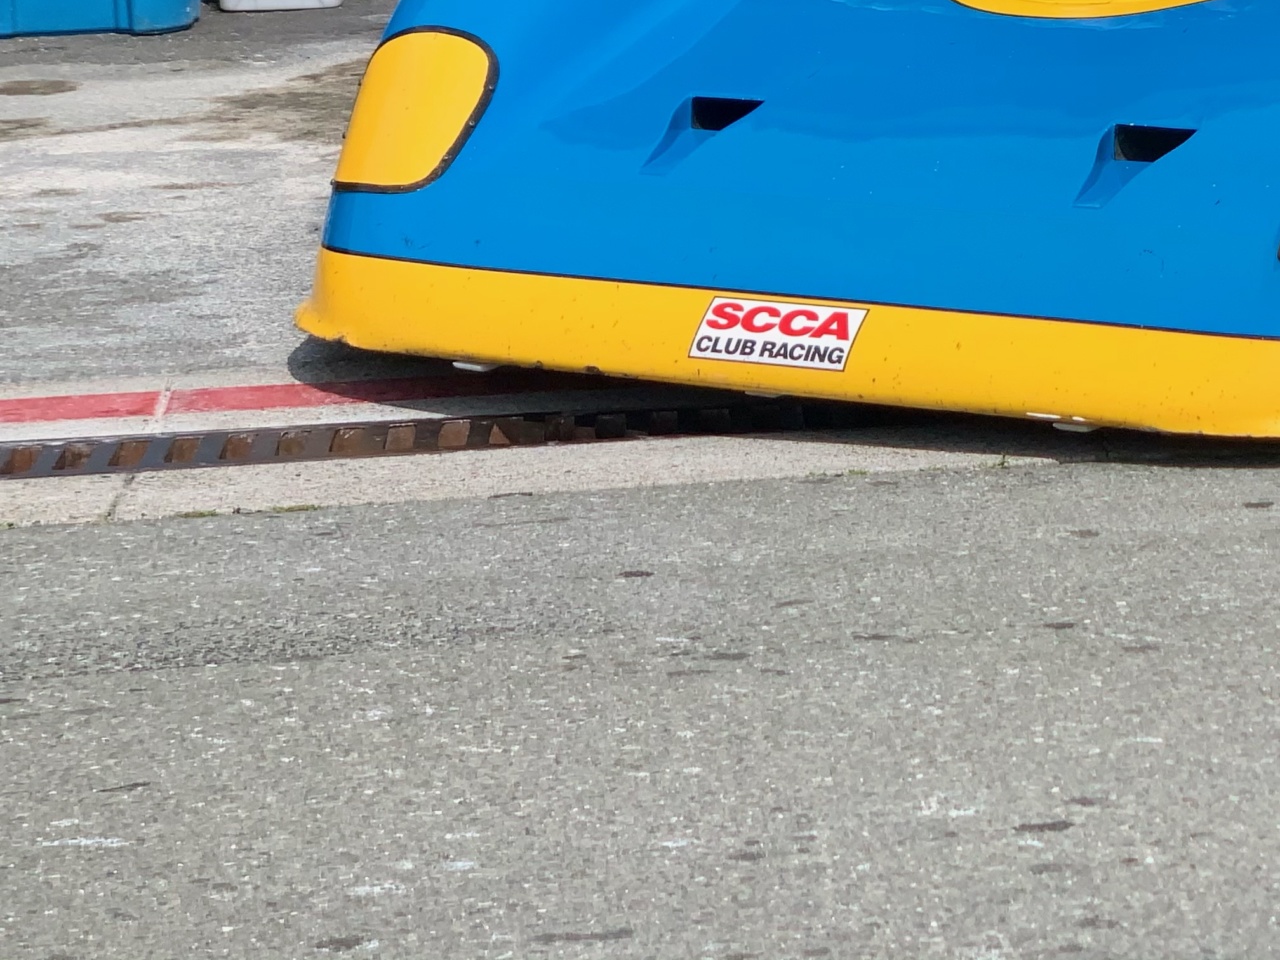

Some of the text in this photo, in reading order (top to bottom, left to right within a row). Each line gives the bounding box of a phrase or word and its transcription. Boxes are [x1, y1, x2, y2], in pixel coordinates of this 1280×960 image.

[705, 302, 850, 341] SCCA
[695, 335, 846, 365] CLUB RACING
